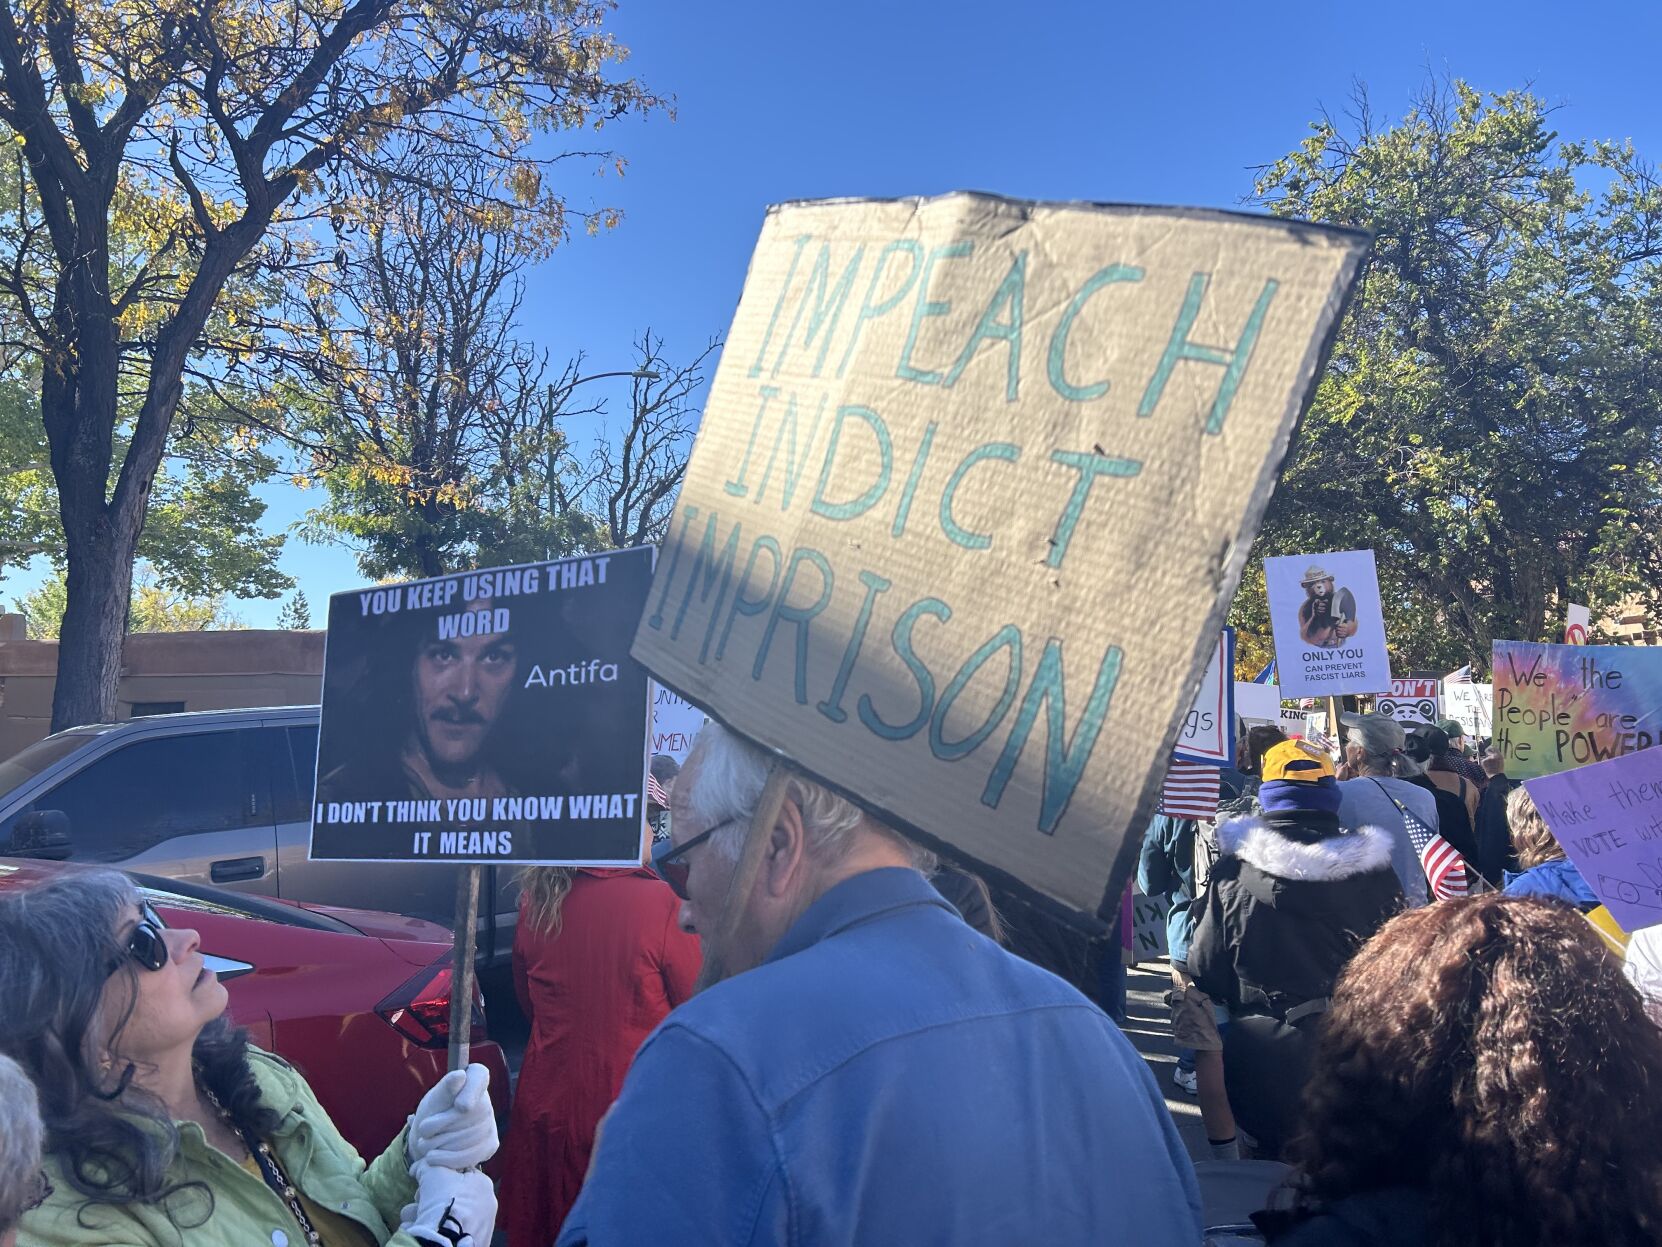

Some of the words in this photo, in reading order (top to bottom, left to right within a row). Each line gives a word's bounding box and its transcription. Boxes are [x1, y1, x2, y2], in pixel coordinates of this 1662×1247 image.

[748, 235, 1277, 435] IMPEACH
[724, 386, 1143, 569] INDICT
[360, 588, 402, 617] YOU
[407, 580, 457, 610] KEEP
[463, 569, 539, 601] USING
[546, 557, 611, 592] THAT
[438, 608, 510, 640] WORD
[1302, 650, 1335, 661] ONLY
[1337, 649, 1364, 659] YOU
[1325, 663, 1363, 671] PREVENT
[524, 659, 618, 688] Antifa
[648, 505, 1125, 835] IMPRISON
[1305, 673, 1340, 681] FASCIST
[1341, 671, 1365, 679] LIARS
[1580, 657, 1623, 689] the
[1378, 679, 1434, 697] ON'T
[1453, 689, 1471, 701] WE
[1596, 712, 1637, 730] are
[1497, 728, 1531, 761] the
[316, 803, 323, 824] I
[327, 802, 382, 823] DON'T
[386, 800, 441, 823] THINK
[447, 798, 487, 822] YOU
[492, 796, 564, 821] KNOW
[569, 794, 638, 819] WHAT
[1543, 801, 1596, 827] Make
[413, 832, 432, 854] IT
[439, 831, 512, 855] MEANS
[1572, 829, 1627, 857] VOTE
